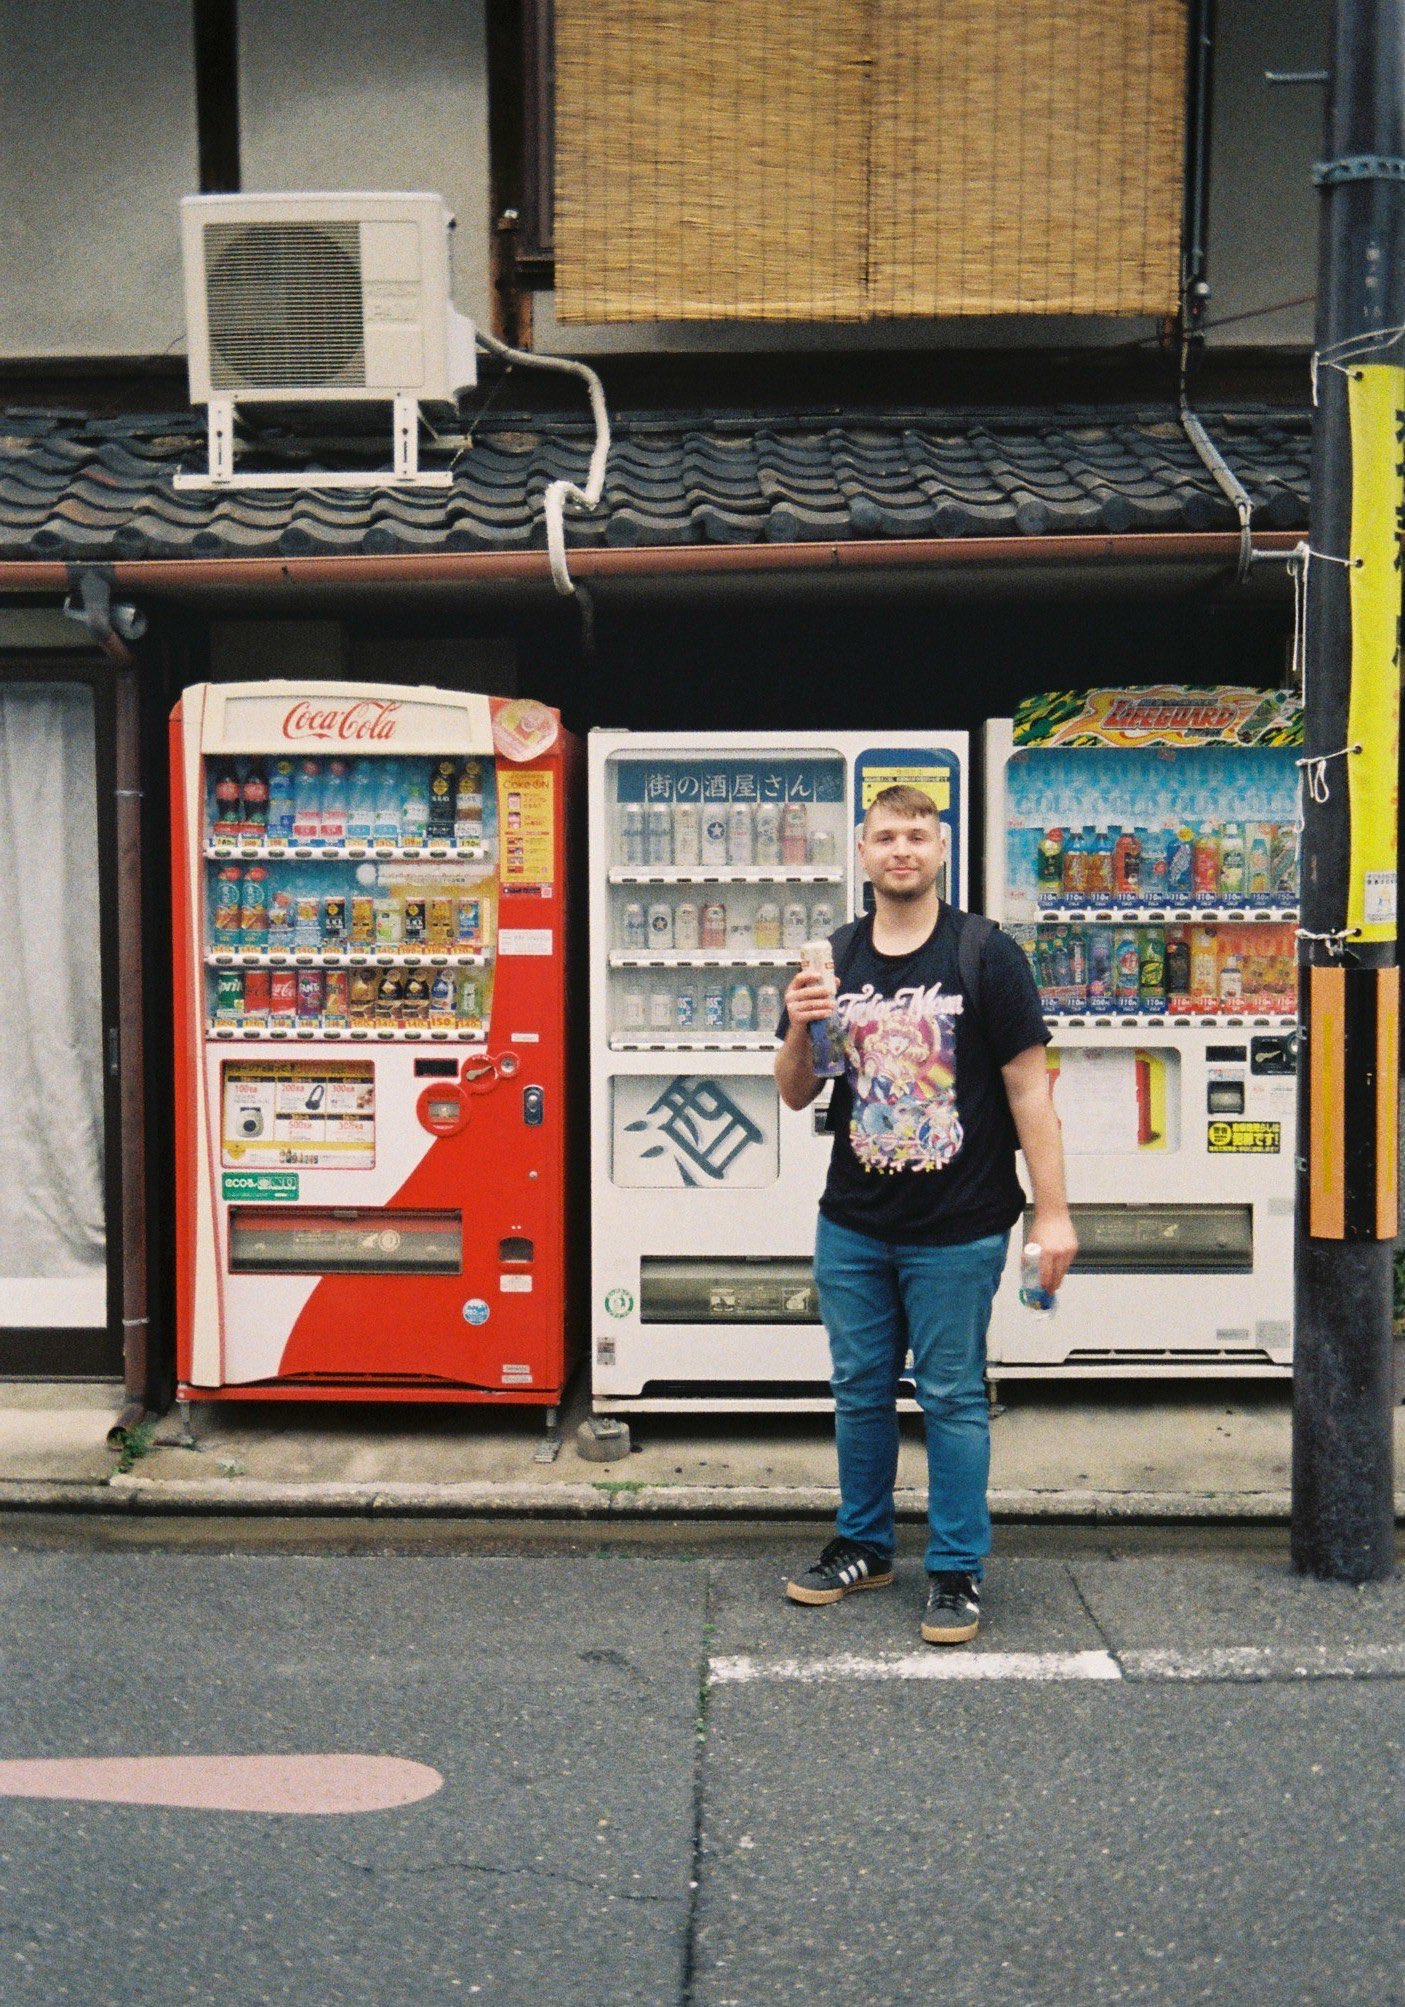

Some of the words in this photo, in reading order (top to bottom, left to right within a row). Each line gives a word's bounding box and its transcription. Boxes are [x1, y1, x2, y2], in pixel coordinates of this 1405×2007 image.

[282, 699, 402, 740] Coca-Cola
[1101, 697, 1238, 730] LIFEGUARD
[646, 773, 812, 799] 街の酒屋さん
[895, 982, 964, 1020] Moon
